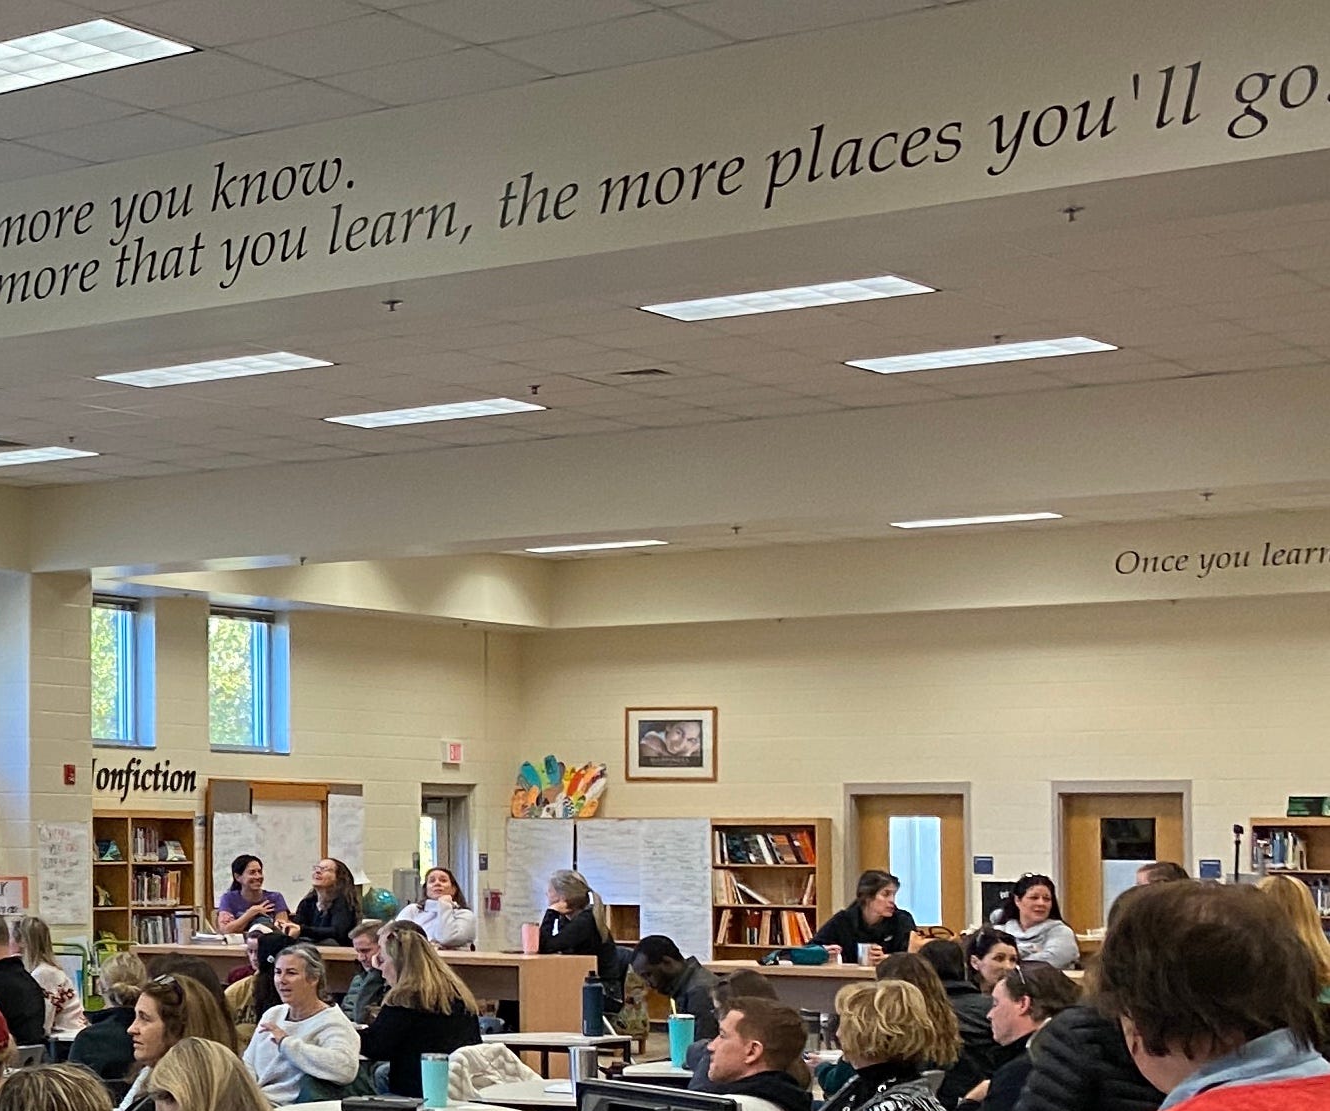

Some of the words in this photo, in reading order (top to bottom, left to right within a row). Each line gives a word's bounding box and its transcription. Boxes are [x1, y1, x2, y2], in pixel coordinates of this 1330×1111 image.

[108, 184, 195, 247] you
[210, 155, 356, 212] know.
[114, 231, 206, 289] that
[218, 224, 308, 290] you
[327, 199, 474, 256] learn,
[499, 171, 580, 230] the
[598, 155, 746, 215] more
[763, 121, 963, 210] places
[985, 60, 1203, 177] you'll
[1115, 550, 1189, 575] Once
[1196, 551, 1250, 579] you
